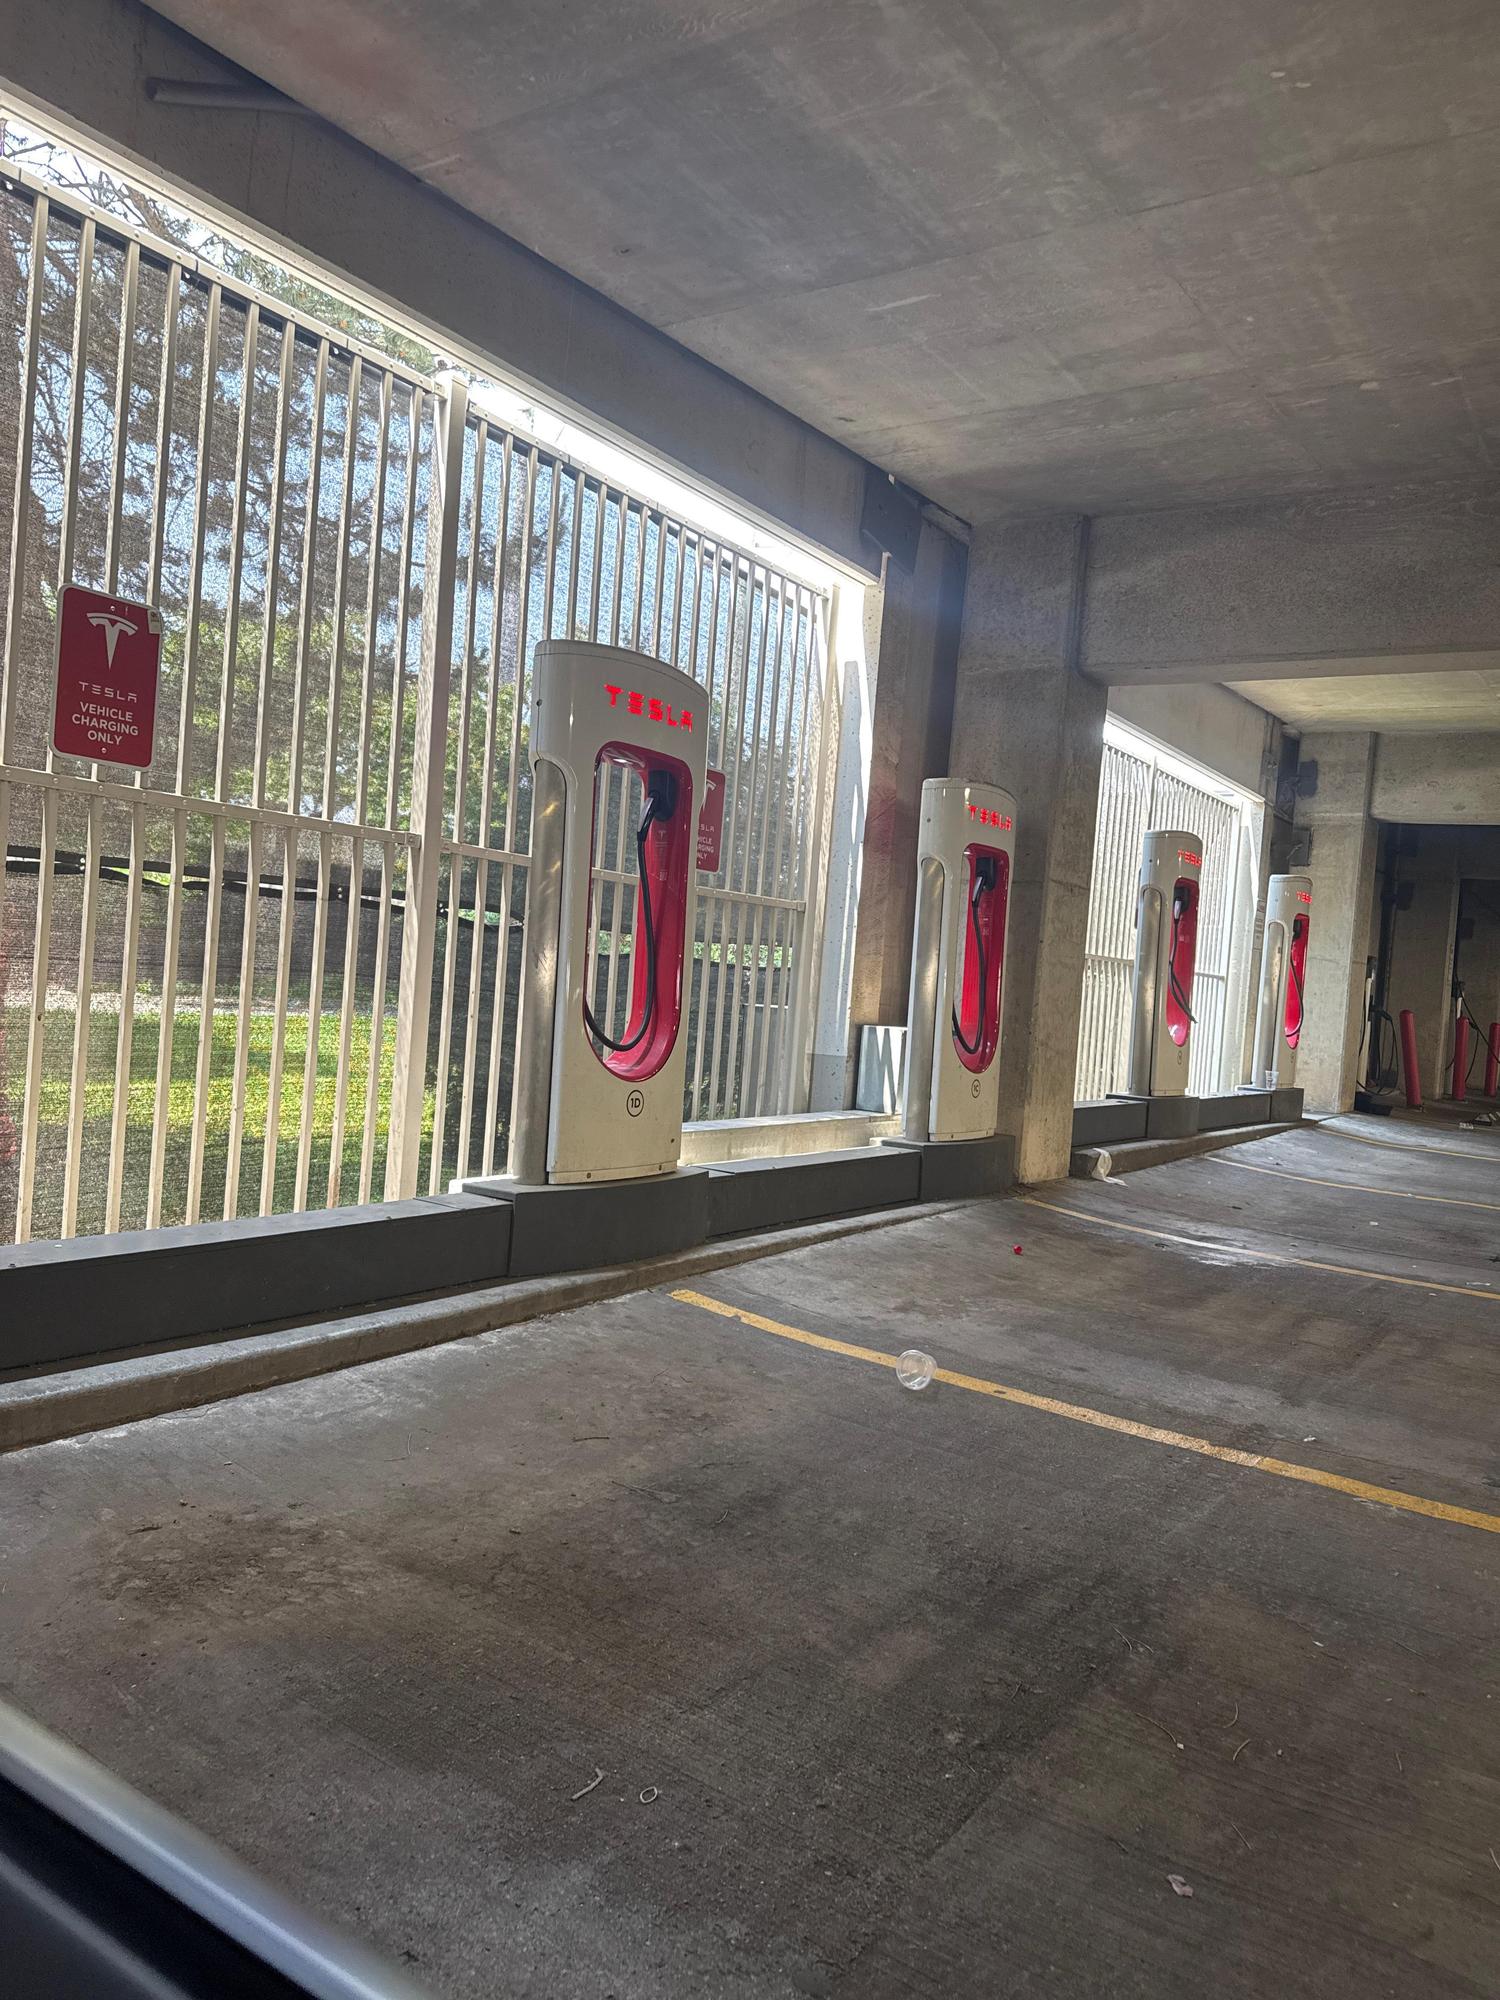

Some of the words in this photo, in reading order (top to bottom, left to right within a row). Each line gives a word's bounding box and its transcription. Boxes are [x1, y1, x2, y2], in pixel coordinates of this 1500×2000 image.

[78, 680, 137, 703] TESLA
[79, 701, 134, 722] VEHICLE
[603, 683, 694, 733] TESLA
[71, 713, 139, 736] CHARGING
[87, 730, 123, 745] ONLY
[699, 823, 715, 832] SLA
[967, 804, 1012, 832] TESLA
[630, 1097, 641, 1108] 1D
